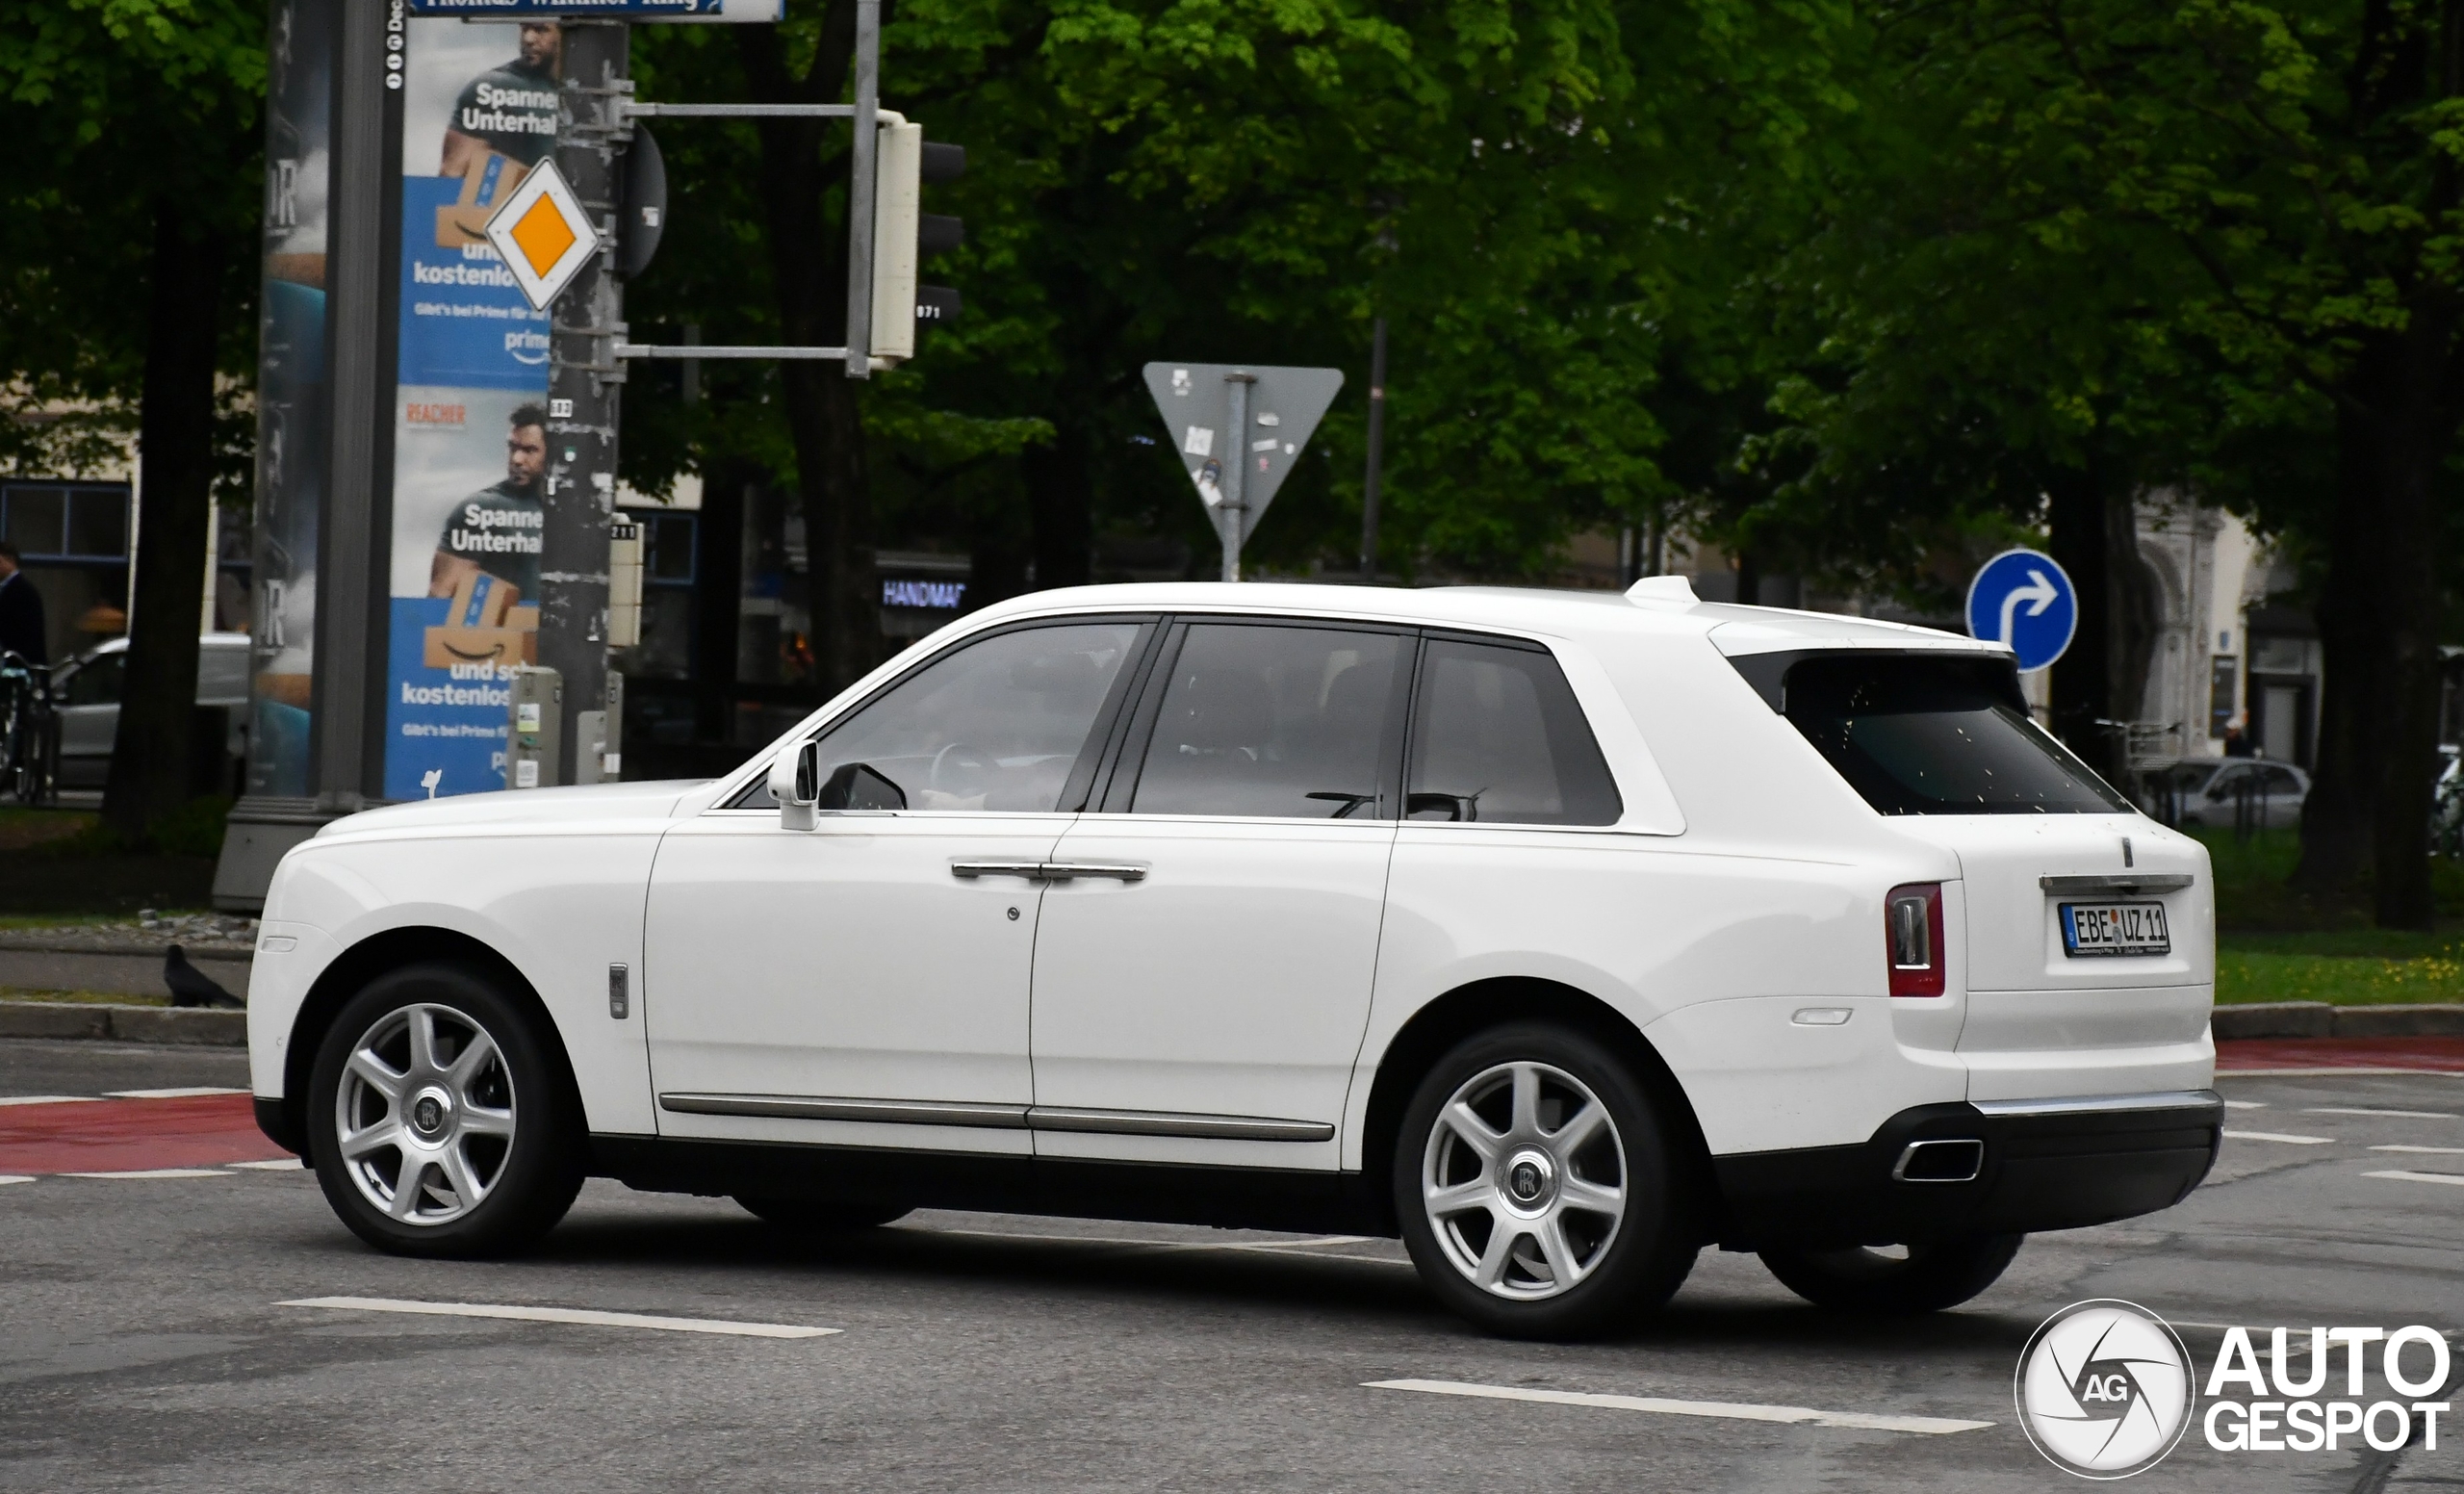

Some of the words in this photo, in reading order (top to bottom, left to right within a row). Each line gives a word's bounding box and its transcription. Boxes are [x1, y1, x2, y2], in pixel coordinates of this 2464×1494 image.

[476, 82, 559, 110] Spanne
[413, 261, 520, 288] kostenlo
[465, 503, 544, 529] Spanne
[449, 658, 495, 682] und
[401, 681, 510, 707] kostenlos
[2074, 910, 2114, 943] EBE
[2120, 909, 2144, 941] UZ
[2145, 909, 2167, 940] 11
